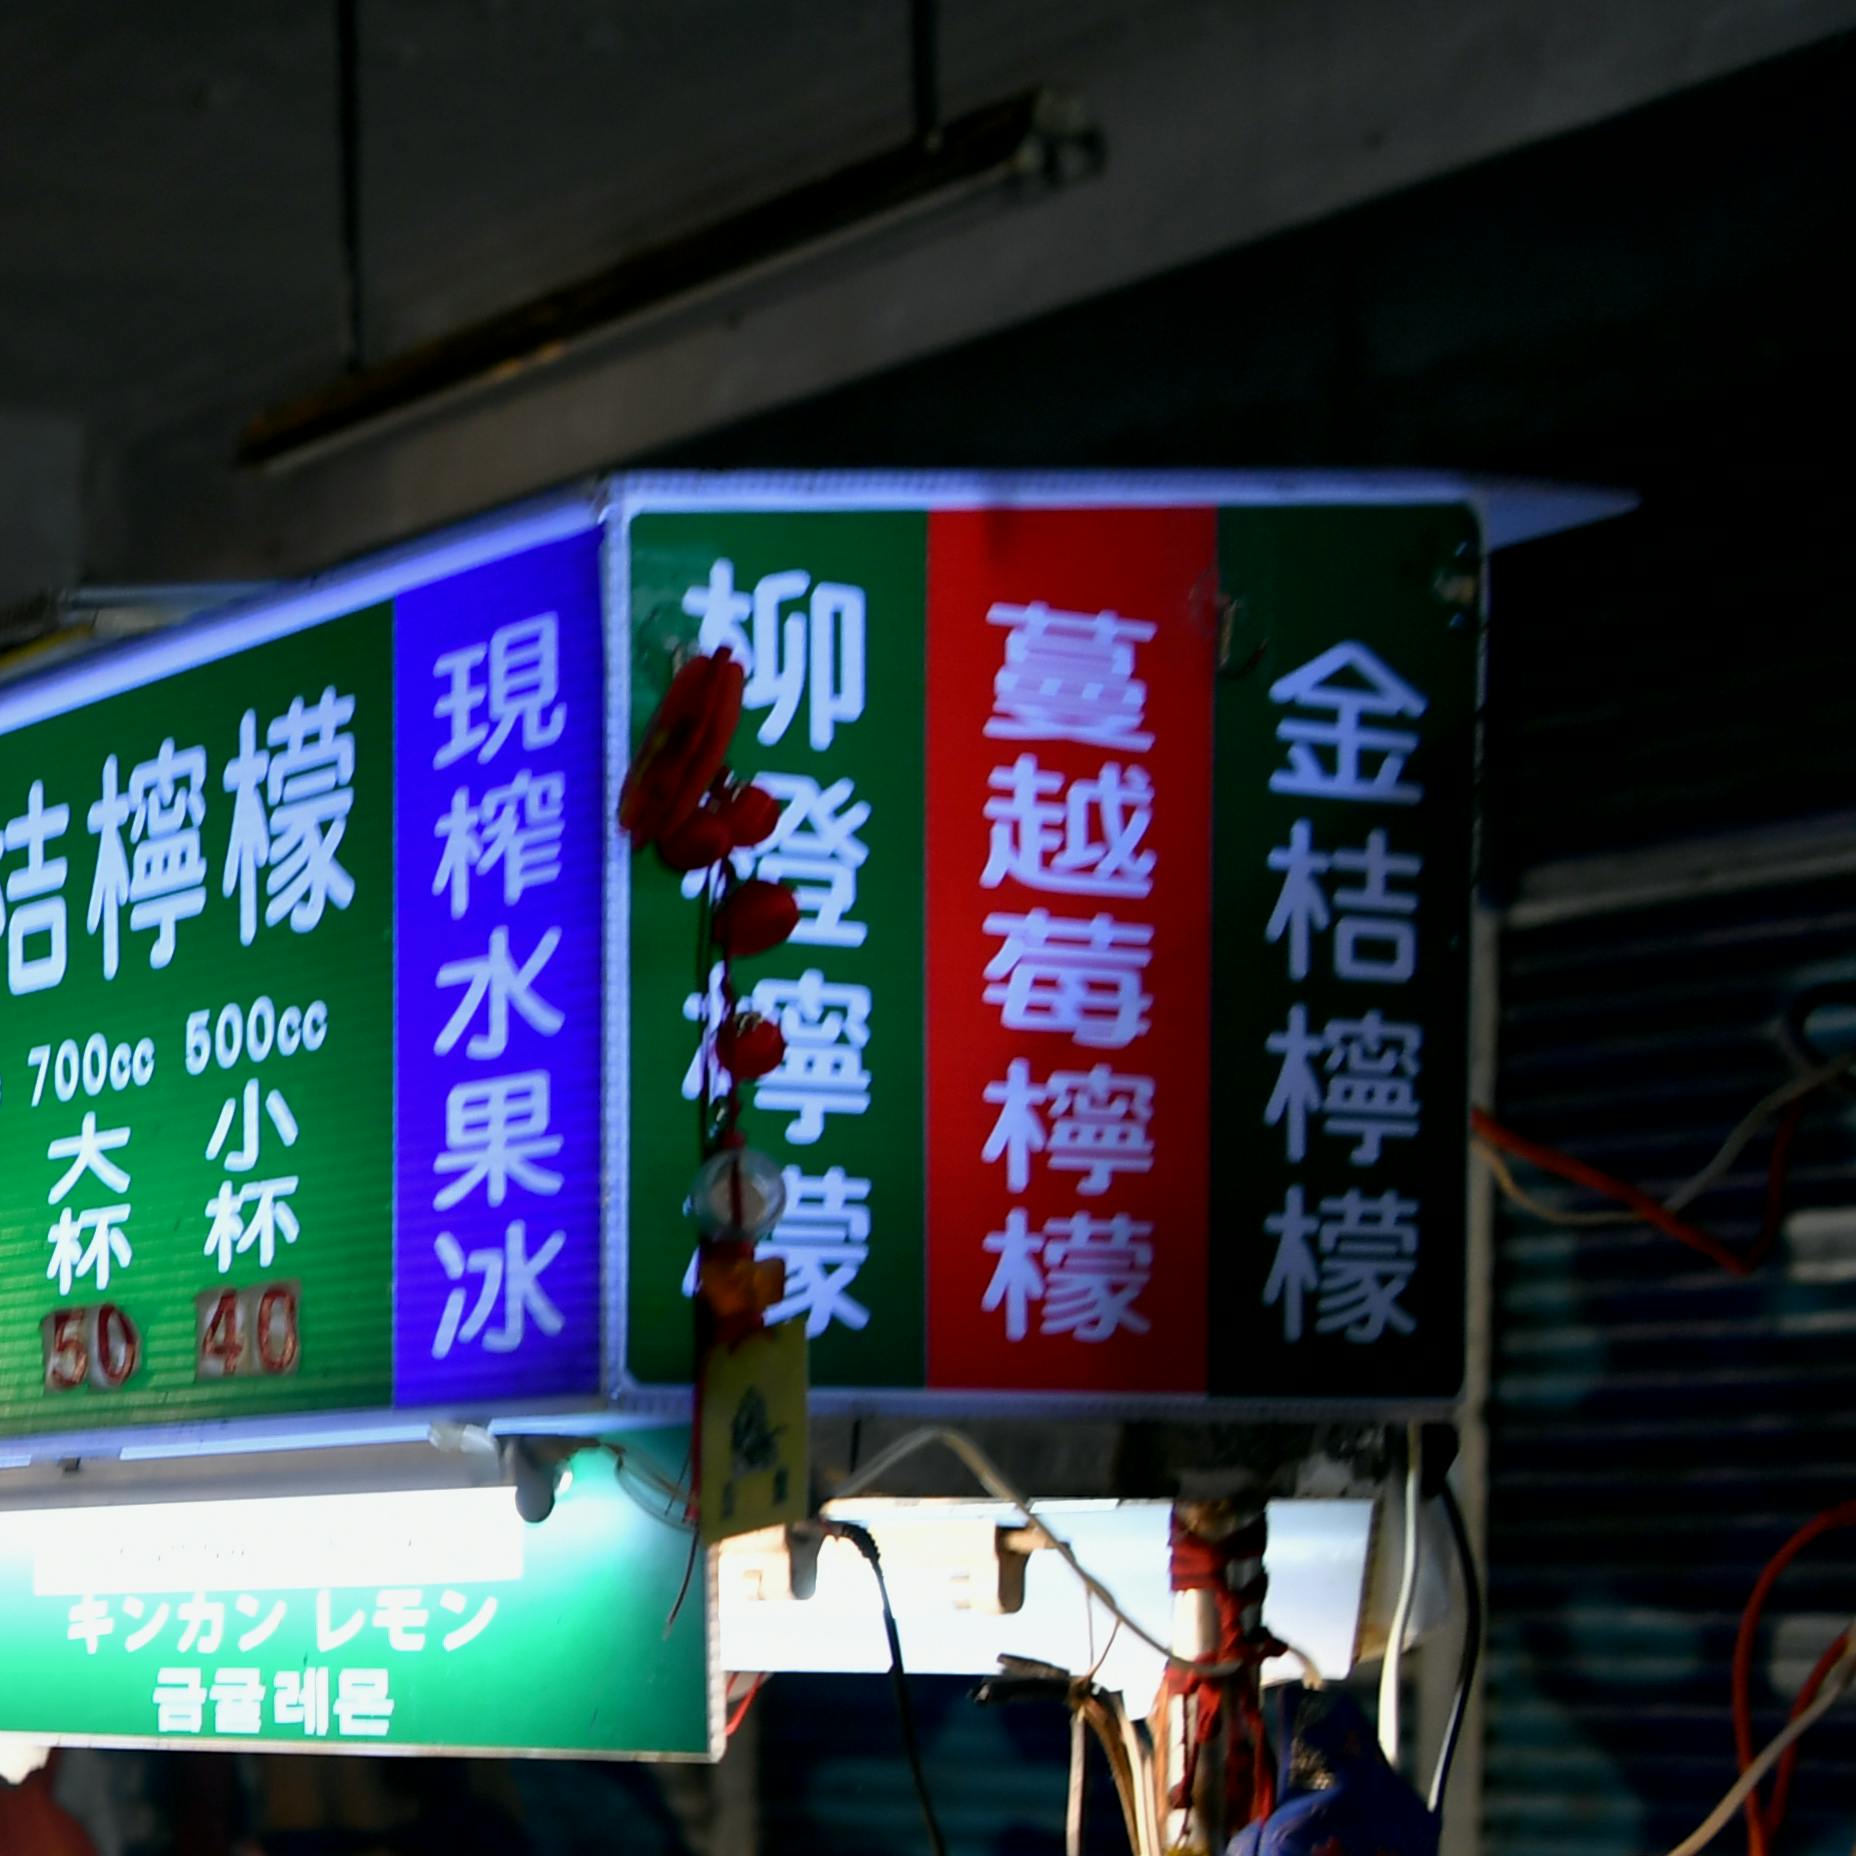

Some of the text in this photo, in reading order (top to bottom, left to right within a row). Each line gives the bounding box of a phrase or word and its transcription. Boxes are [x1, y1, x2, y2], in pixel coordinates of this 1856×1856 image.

[27, 1032, 156, 1107] 700cc
[184, 995, 329, 1076] 500cc
[432, 609, 566, 1359] 現榨水果冰
[980, 600, 1158, 1344] 蔓越莓檸檬
[1263, 639, 1427, 1344] 金桔檸檬
[46, 1110, 132, 1297] 大杯
[204, 1077, 300, 1274] 小杯
[51, 1303, 136, 1388] 50
[202, 1283, 298, 1374] 40
[67, 1588, 498, 1655] キンカン レモン
